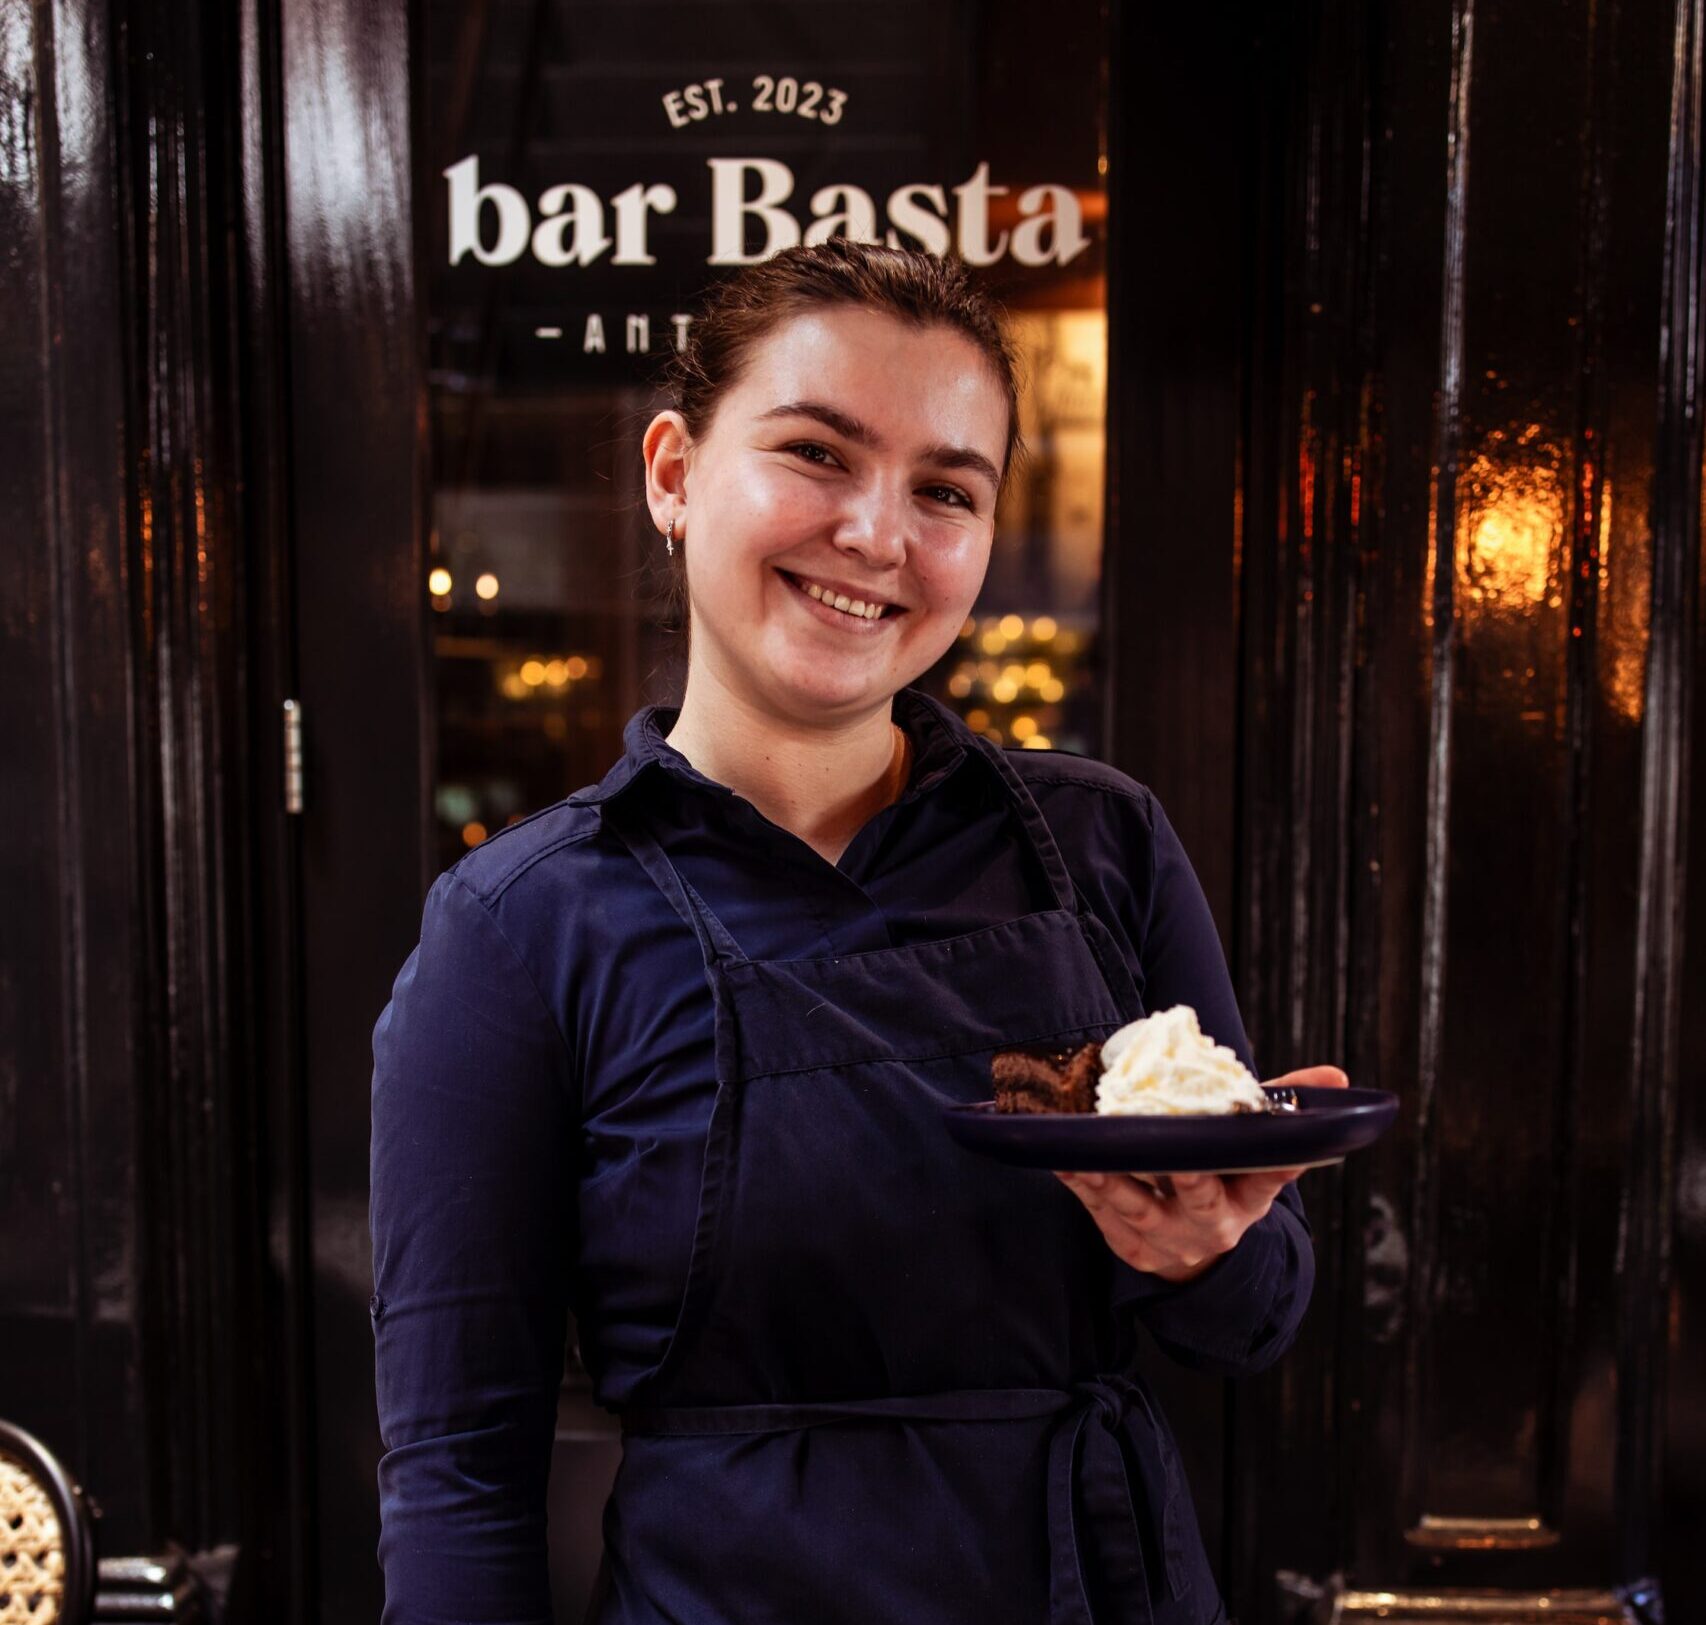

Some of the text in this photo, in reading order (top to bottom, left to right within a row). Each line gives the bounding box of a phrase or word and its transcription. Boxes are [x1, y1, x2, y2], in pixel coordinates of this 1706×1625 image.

[663, 76, 848, 128] EST. 2023
[443, 154, 1090, 267] bar Basta
[582, 313, 694, 354] ANT
